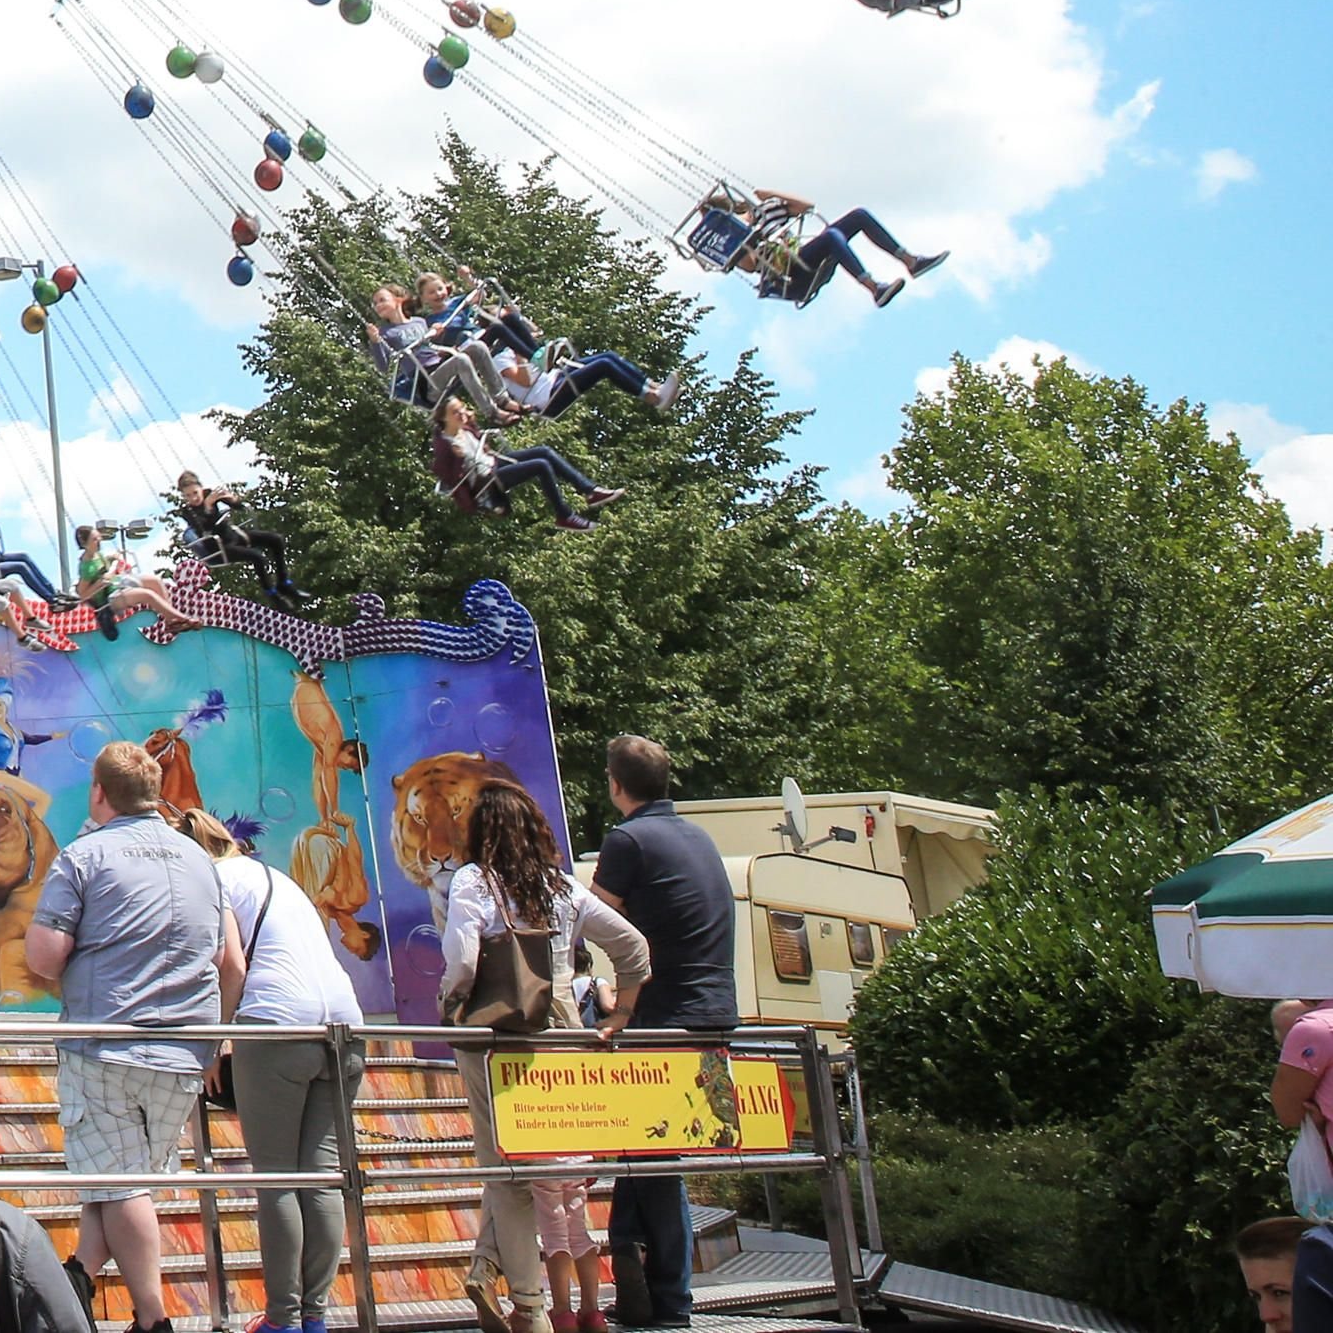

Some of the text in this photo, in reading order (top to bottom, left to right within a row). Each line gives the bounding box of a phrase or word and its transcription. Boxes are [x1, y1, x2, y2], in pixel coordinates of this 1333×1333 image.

[500, 1060, 672, 1092] Fliegen ist schön!
[514, 1101, 607, 1114] Bitte setzen Sie kleine
[515, 1116, 630, 1130] Kinder in den inneren Sitz!
